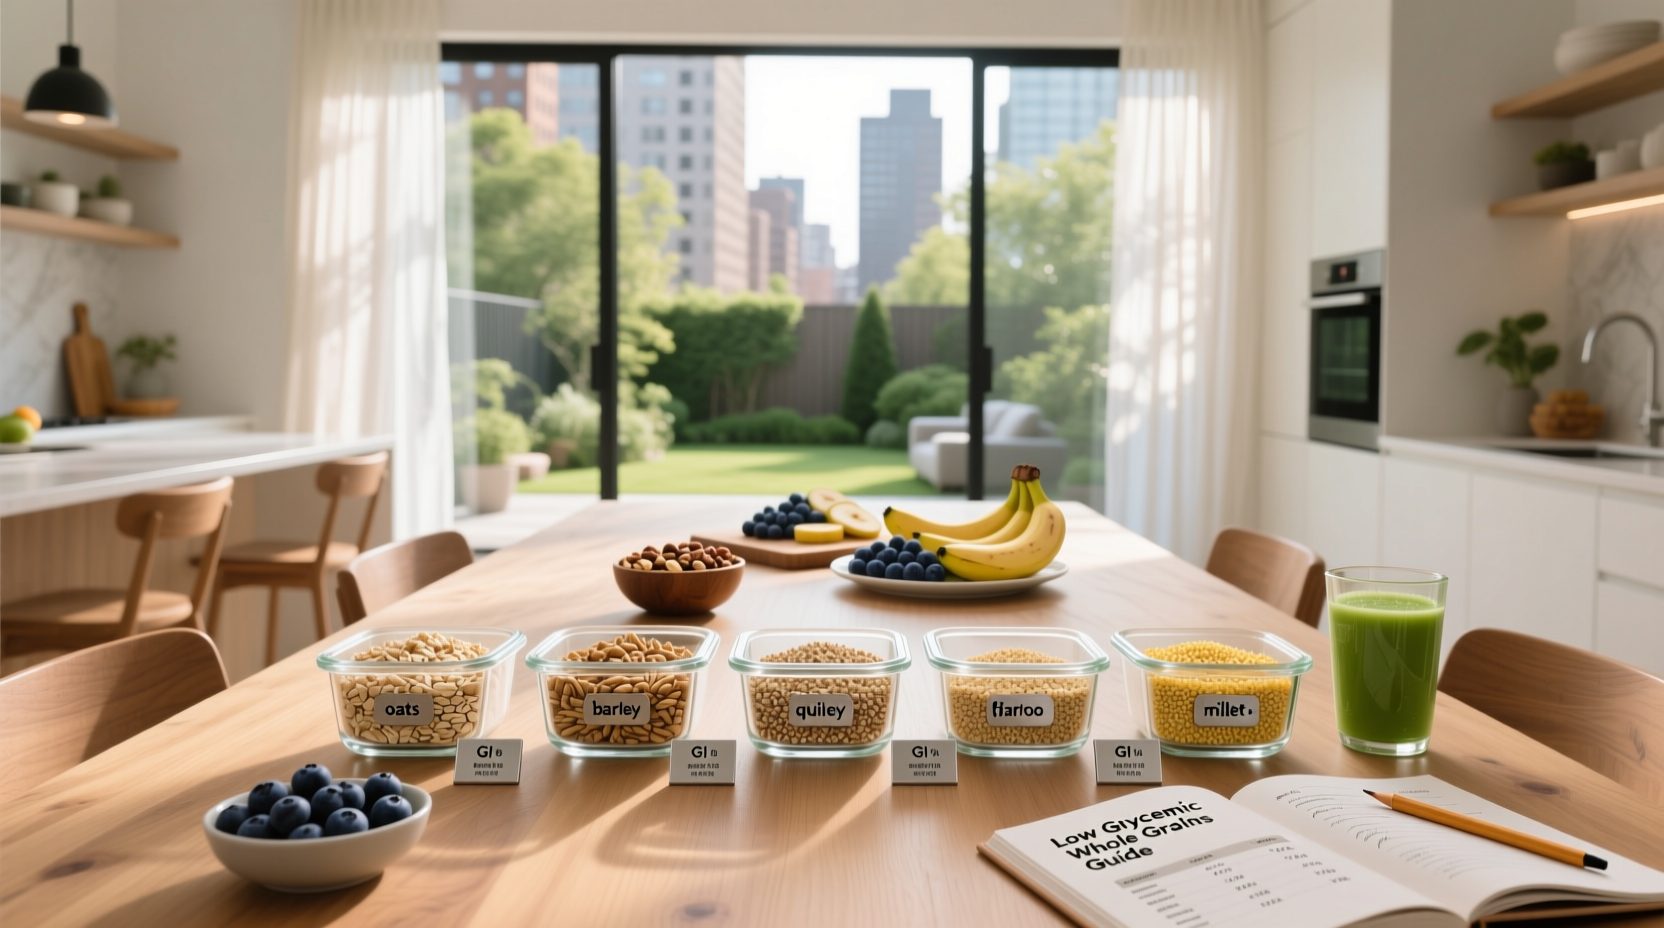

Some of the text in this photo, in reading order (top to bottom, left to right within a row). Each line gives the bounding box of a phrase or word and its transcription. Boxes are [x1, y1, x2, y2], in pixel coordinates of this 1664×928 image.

[385, 702, 420, 716] oats
[592, 700, 641, 720] barley
[795, 701, 846, 721] quiley
[1050, 828, 1097, 848] Low
[1065, 834, 1138, 859] Whole
[1085, 846, 1154, 870] Guide
